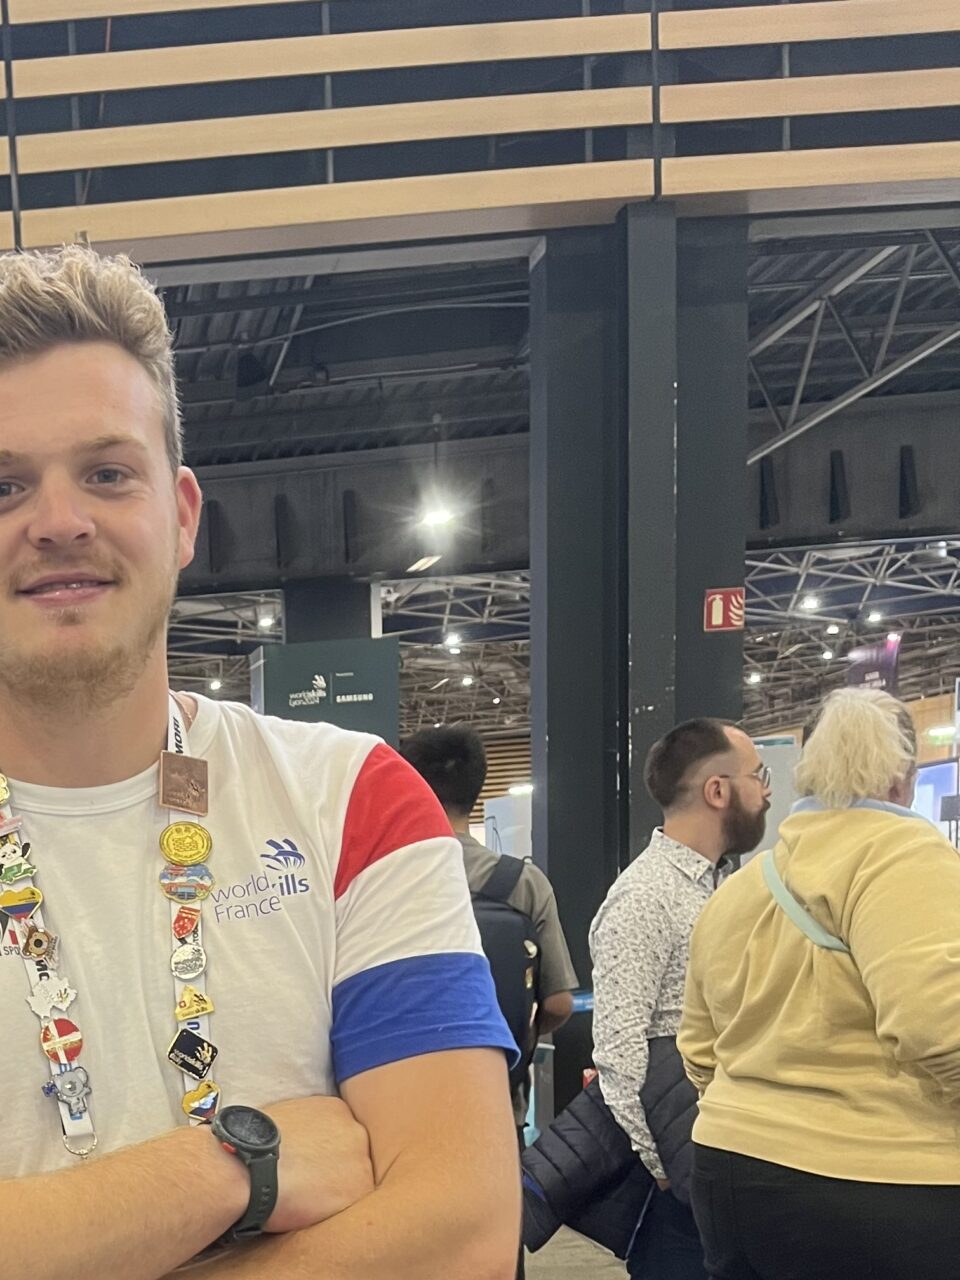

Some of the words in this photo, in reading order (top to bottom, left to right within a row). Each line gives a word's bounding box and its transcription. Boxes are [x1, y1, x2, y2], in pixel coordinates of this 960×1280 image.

[336, 693, 374, 703] SAMSUNG
[214, 895, 282, 923] France
[3, 945, 21, 956] SPO
